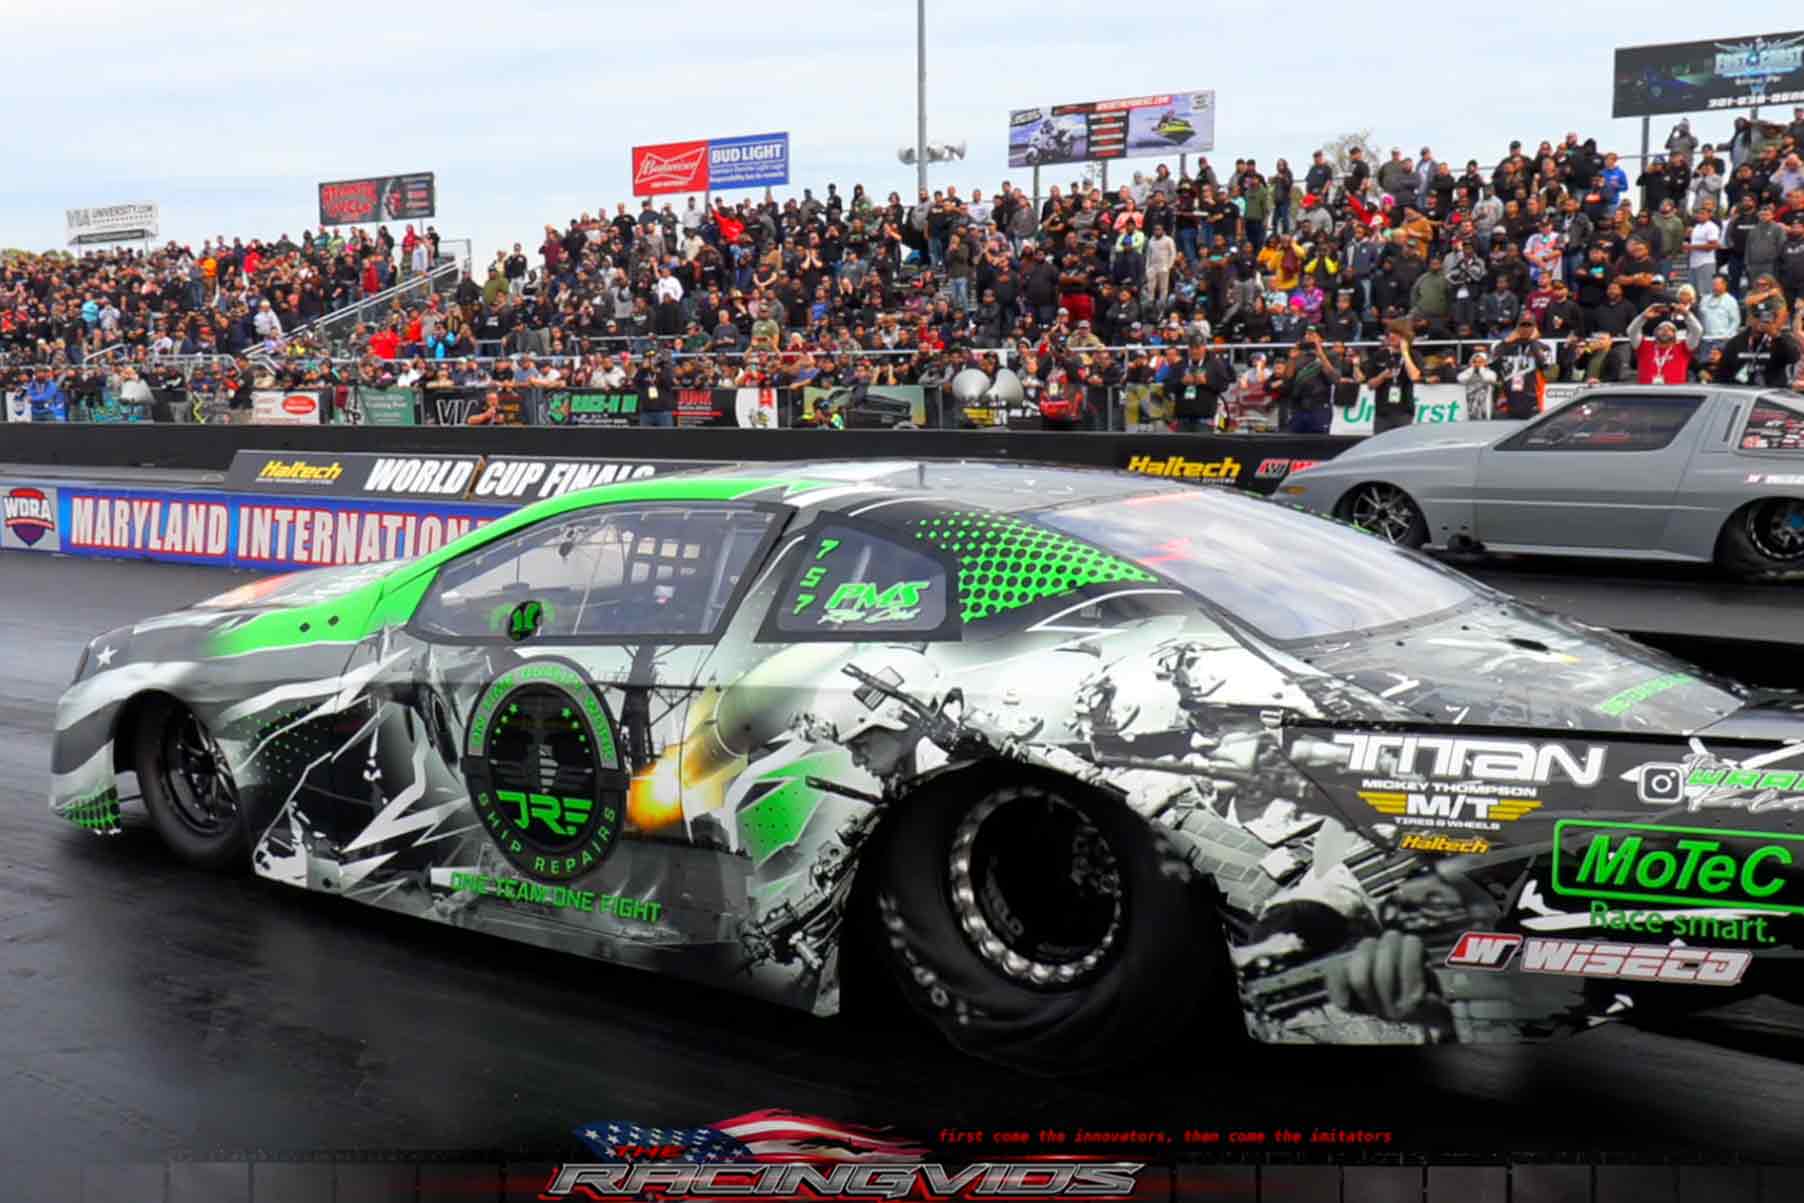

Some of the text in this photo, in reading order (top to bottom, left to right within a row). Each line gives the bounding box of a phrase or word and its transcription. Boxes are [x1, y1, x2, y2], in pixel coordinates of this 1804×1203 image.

[712, 144, 783, 163] BUD LIGHT
[260, 460, 344, 480] Haltech
[363, 458, 474, 494] WORLD
[475, 461, 546, 497] CUP
[1128, 456, 1241, 478] Haltech
[3, 496, 52, 522] WDRA
[71, 497, 229, 555] MARYLAND
[1361, 779, 1538, 798] MICKEY THOMPSON
[496, 790, 593, 836] JRE
[1407, 793, 1499, 820] M/T
[1394, 817, 1434, 827] TIRES
[1449, 820, 1501, 831] WHEELS
[534, 806, 617, 876] REPAIRS
[1402, 834, 1489, 854] Haltech
[1576, 834, 1793, 898] MoTeC
[451, 871, 490, 896] ONE
[550, 884, 596, 913] ONE
[600, 894, 663, 925] FIGHT
[1590, 900, 1777, 944] Race smart.
